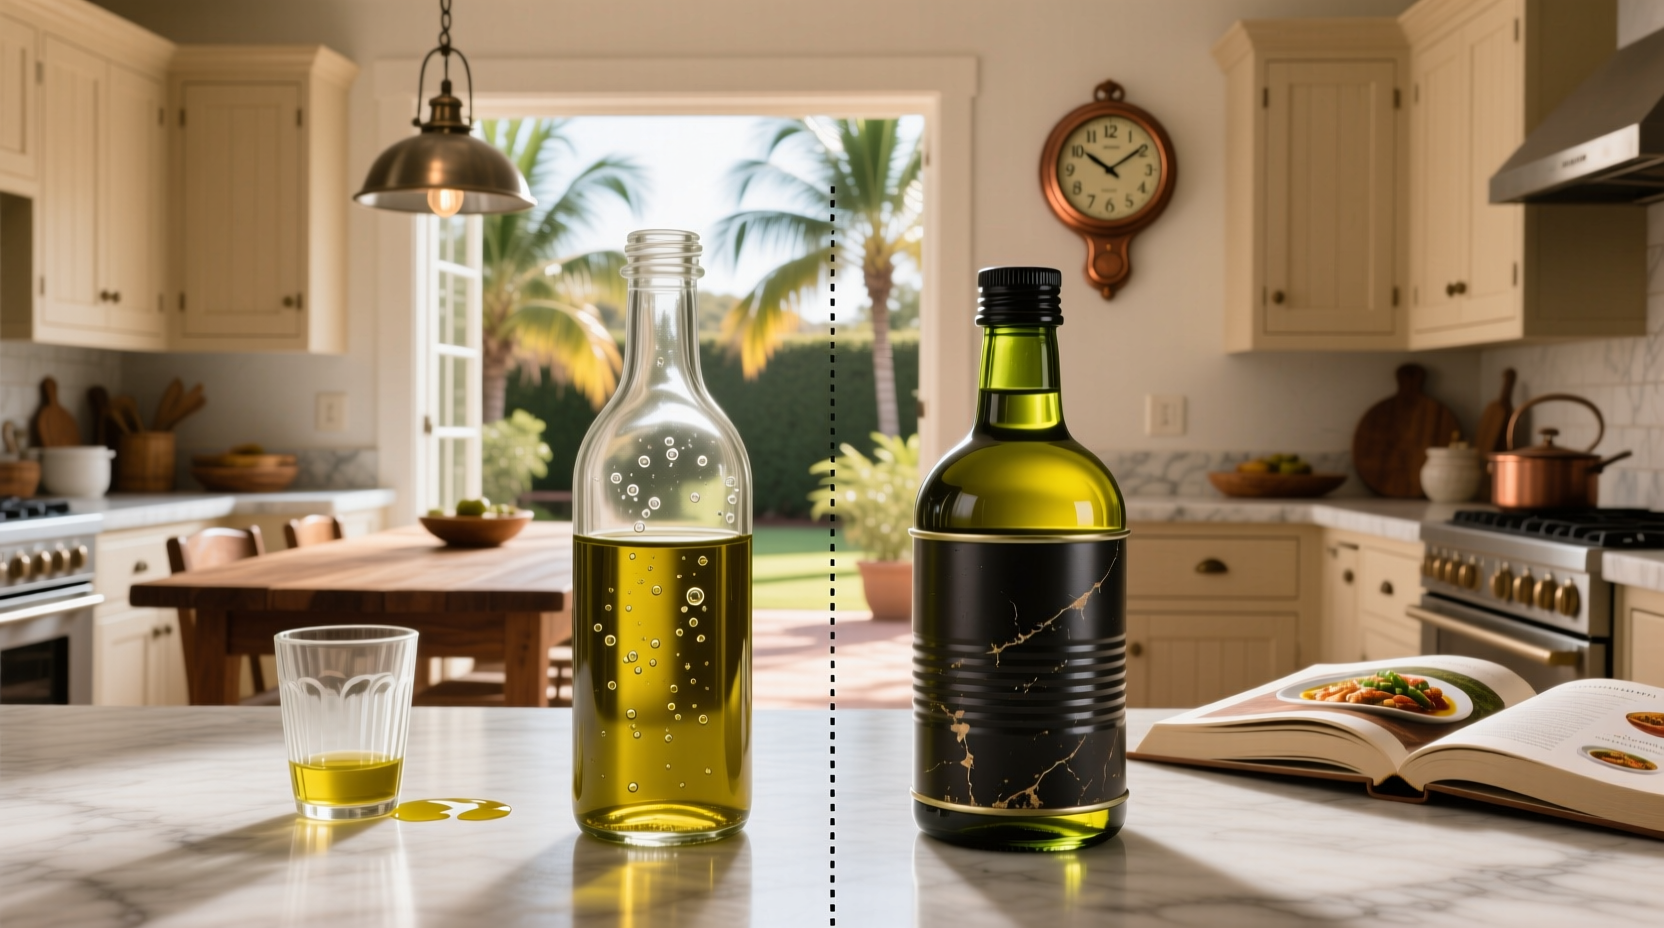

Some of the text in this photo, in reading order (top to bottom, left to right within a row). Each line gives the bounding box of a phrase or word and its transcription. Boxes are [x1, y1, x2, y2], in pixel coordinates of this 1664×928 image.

[1087, 130, 1096, 143] 11
[1104, 125, 1118, 138] 12
[1128, 130, 1132, 143] 1
[1072, 145, 1084, 158] 10
[1138, 143, 1149, 157] 2
[1066, 163, 1075, 176] 9
[1145, 163, 1153, 176] 3
[1072, 181, 1082, 195] 8
[1137, 181, 1146, 194] 4
[1087, 194, 1096, 208] 7
[1105, 198, 1115, 213] 6
[1125, 194, 1134, 208] 5
